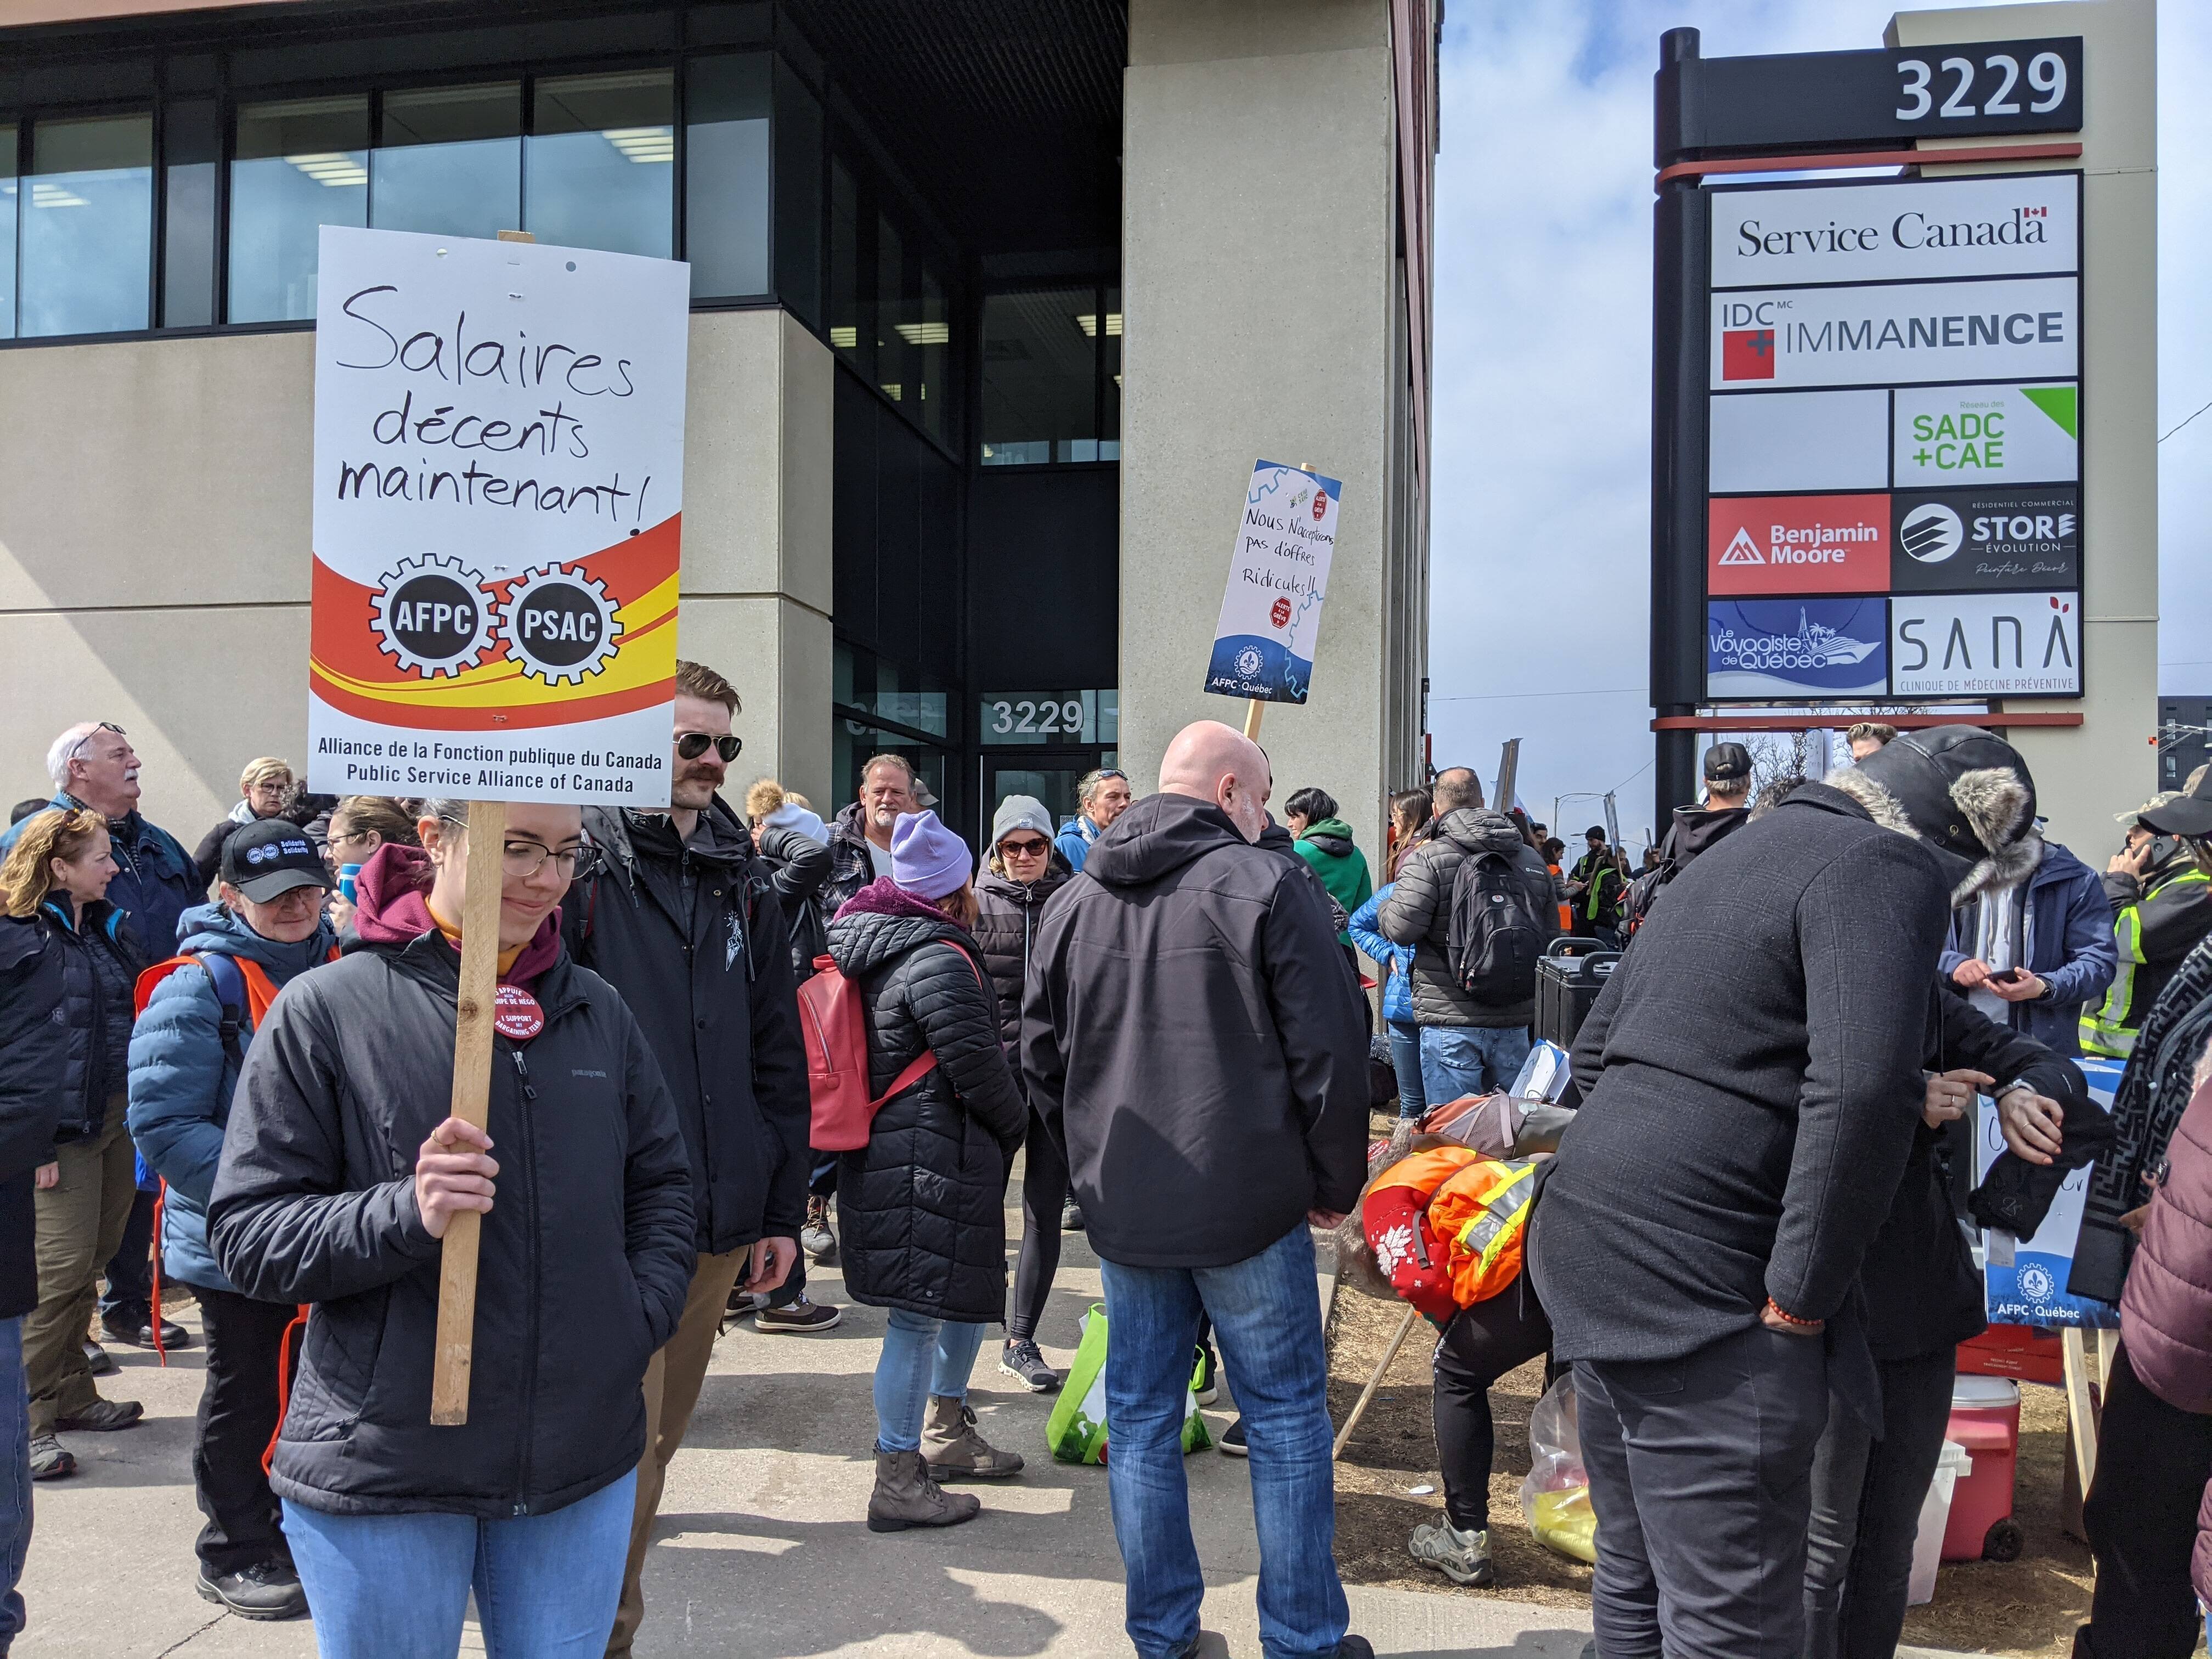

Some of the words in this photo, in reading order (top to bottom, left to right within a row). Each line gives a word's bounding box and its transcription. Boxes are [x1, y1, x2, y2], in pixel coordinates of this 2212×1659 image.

[1896, 52, 2067, 120] 3229
[1738, 221, 1878, 256] Service
[1892, 208, 2047, 249] Canada
[1724, 302, 1773, 327] IDC
[1777, 301, 1793, 309] MC
[336, 285, 634, 397] Salaires
[1786, 312, 2063, 353] IMMANENCE
[373, 390, 589, 458] décents
[1913, 412, 2004, 442] SADC
[338, 458, 651, 537] maintenant!
[1771, 522, 1878, 548] Benjamin
[1972, 514, 2075, 541] STORE
[1771, 545, 1845, 564] Moore
[1986, 543, 2060, 553] ÉVOLUTION
[396, 601, 471, 635] AFPC
[1273, 612, 1286, 622] GRÈVE
[1276, 602, 1290, 612] ALERTE
[524, 610, 596, 642] PSAC
[1721, 628, 1734, 638] Le
[1711, 634, 1801, 656] Voyagiste
[1722, 656, 1737, 665] de
[1739, 651, 1828, 669] Québec
[1211, 677, 1238, 689] AFPC
[1242, 682, 1272, 694] Québec
[1900, 680, 1944, 691] CLINIQUE
[1948, 680, 1959, 691] DE
[1964, 678, 2010, 690] MÉDECINE
[2015, 677, 2073, 689] PRÉVENTIVE
[992, 700, 1084, 734] 3229
[318, 737, 382, 756] Alliance
[388, 741, 407, 757] de
[414, 742, 427, 758] la
[434, 743, 503, 762] Fonction
[509, 748, 575, 768] publique
[582, 751, 600, 766] du
[606, 752, 662, 770] Canada
[347, 764, 400, 782] Public
[407, 766, 471, 785] Service
[478, 770, 543, 788] Alliance
[550, 774, 566, 789] of
[573, 774, 633, 792] Canada
[518, 997, 535, 1005] NÉGO
[495, 1020, 529, 1035] BARGAINING
[528, 1020, 541, 1032] TEAM
[1997, 1303, 2029, 1316] AFPC
[2035, 1306, 2080, 1318] Québec
